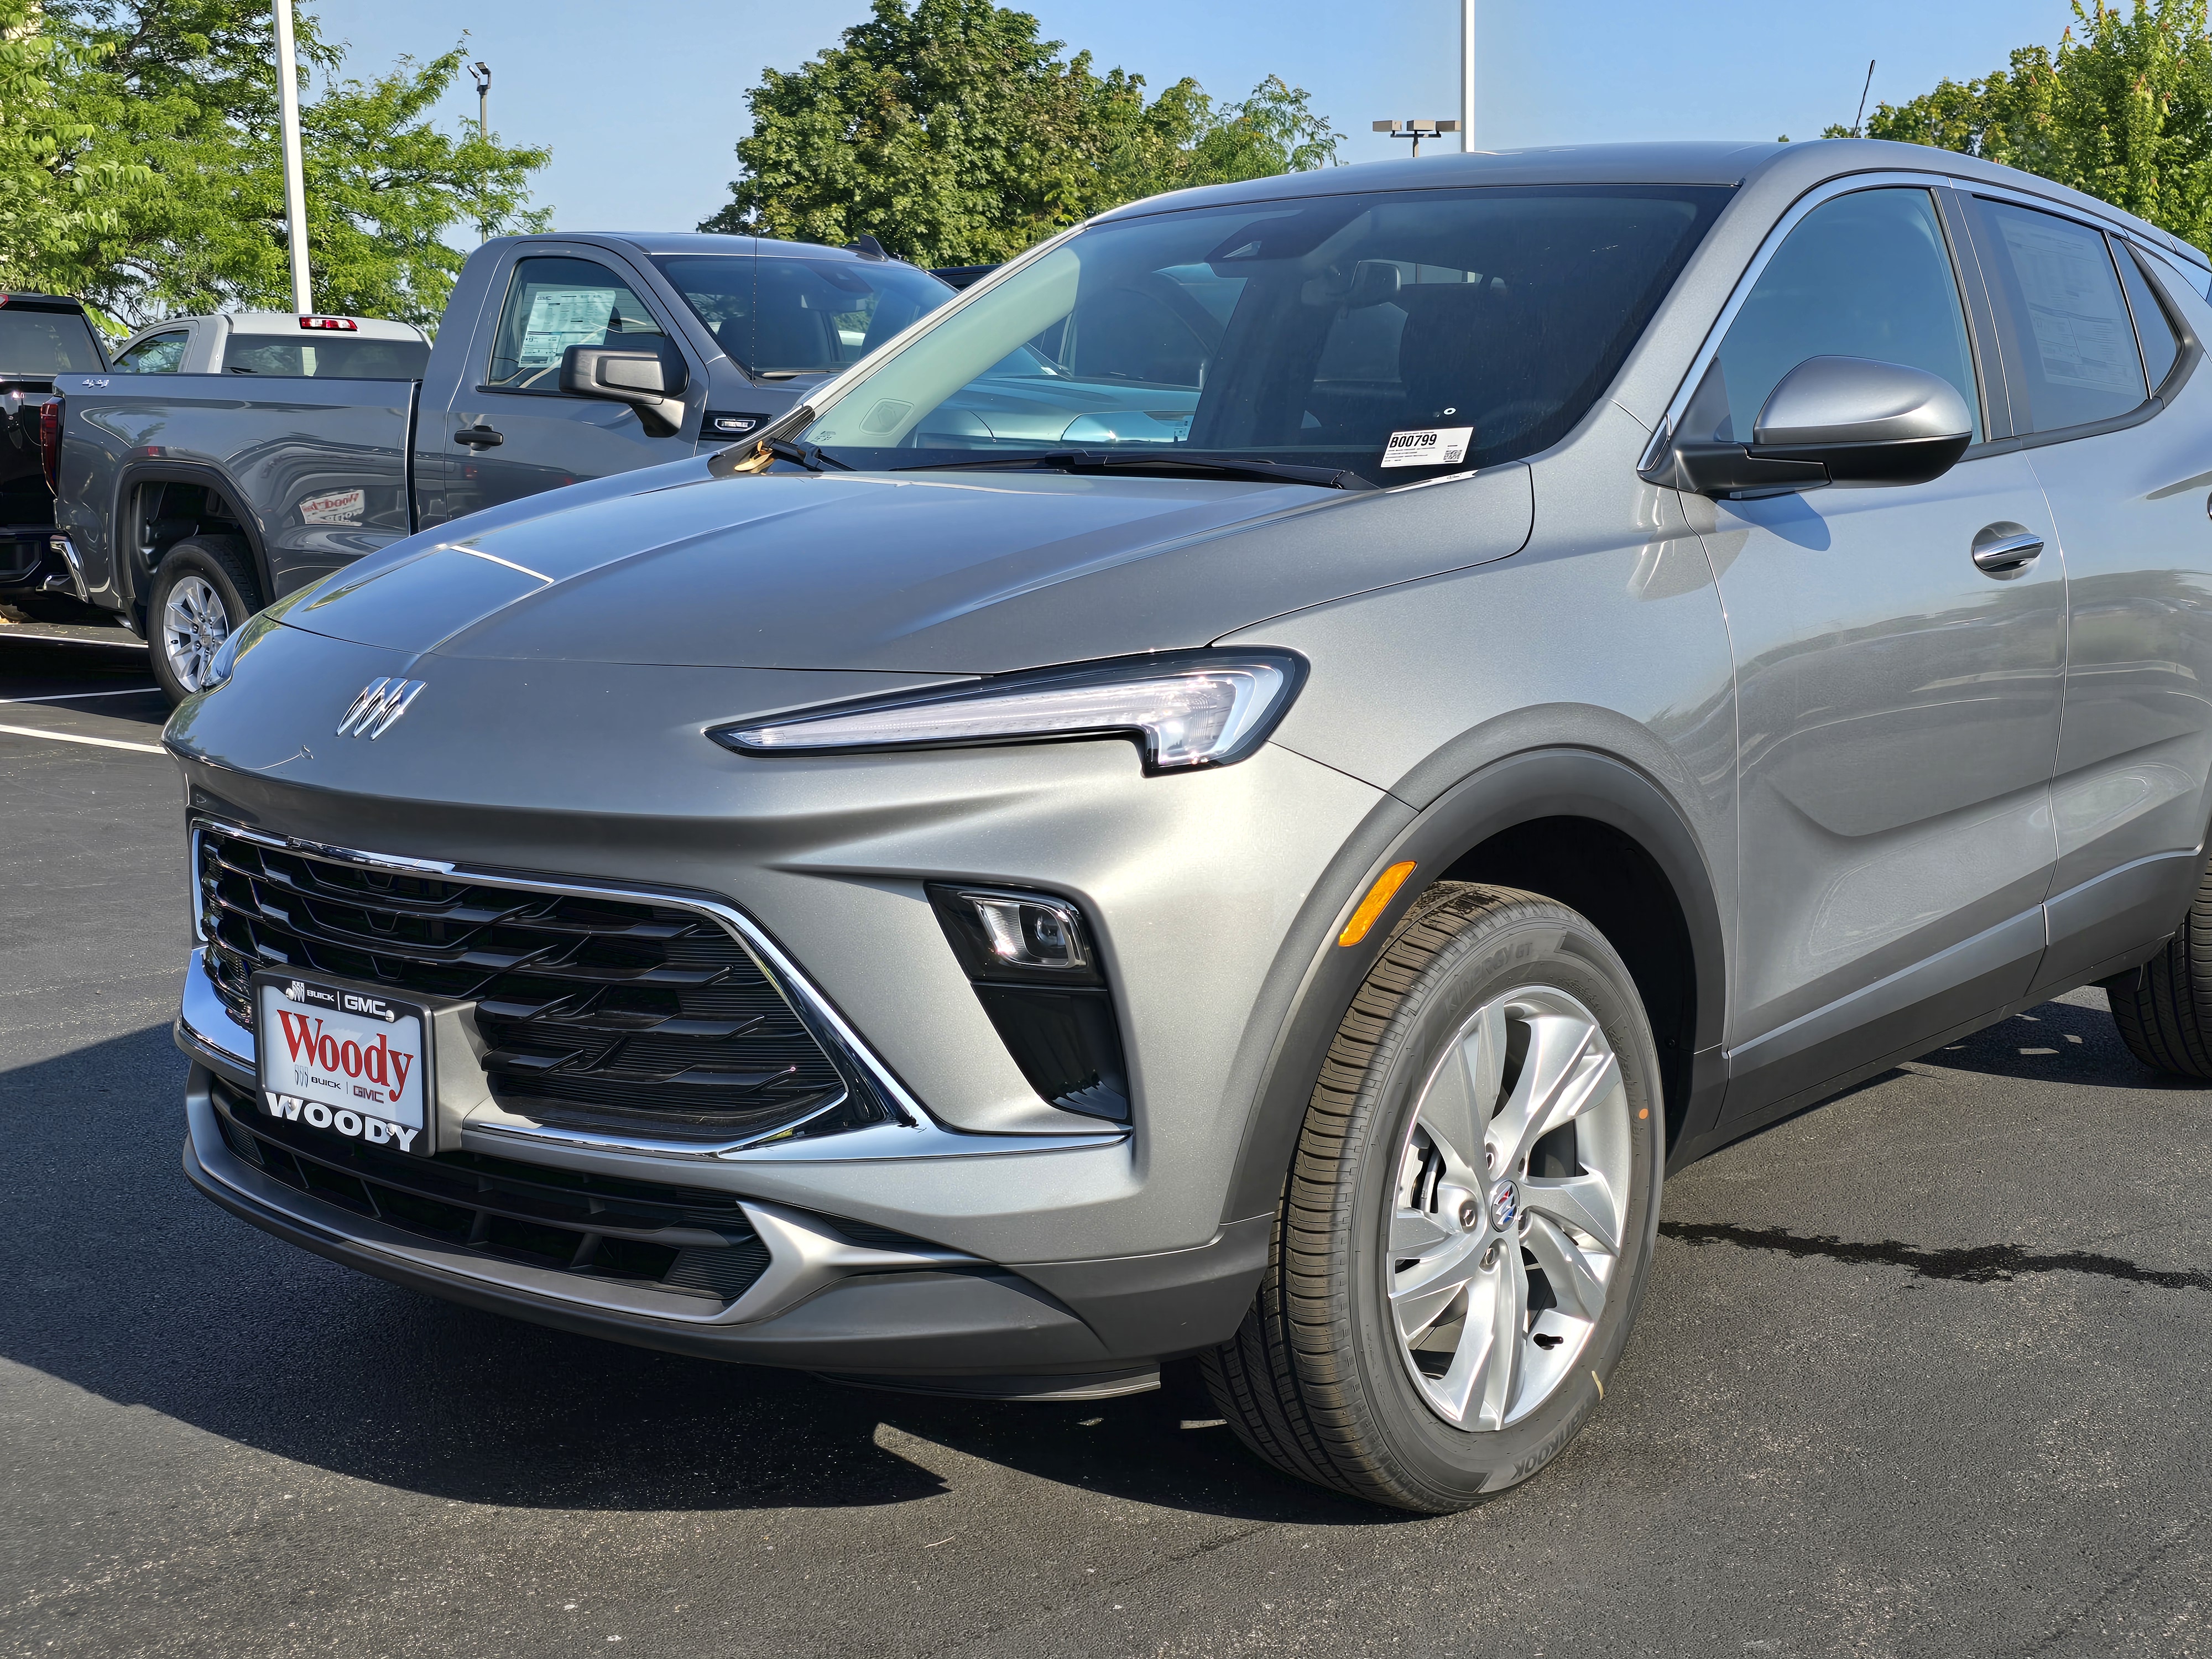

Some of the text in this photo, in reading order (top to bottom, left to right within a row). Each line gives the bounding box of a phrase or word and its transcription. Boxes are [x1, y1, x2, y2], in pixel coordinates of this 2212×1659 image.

[1389, 434, 1437, 448] B00799
[1515, 942, 1533, 959] GT
[306, 989, 387, 1016] BUICK GMC
[276, 1009, 414, 1102] Woody
[311, 1076, 385, 1104] BUICK GMC
[265, 1091, 419, 1152] WOODY
